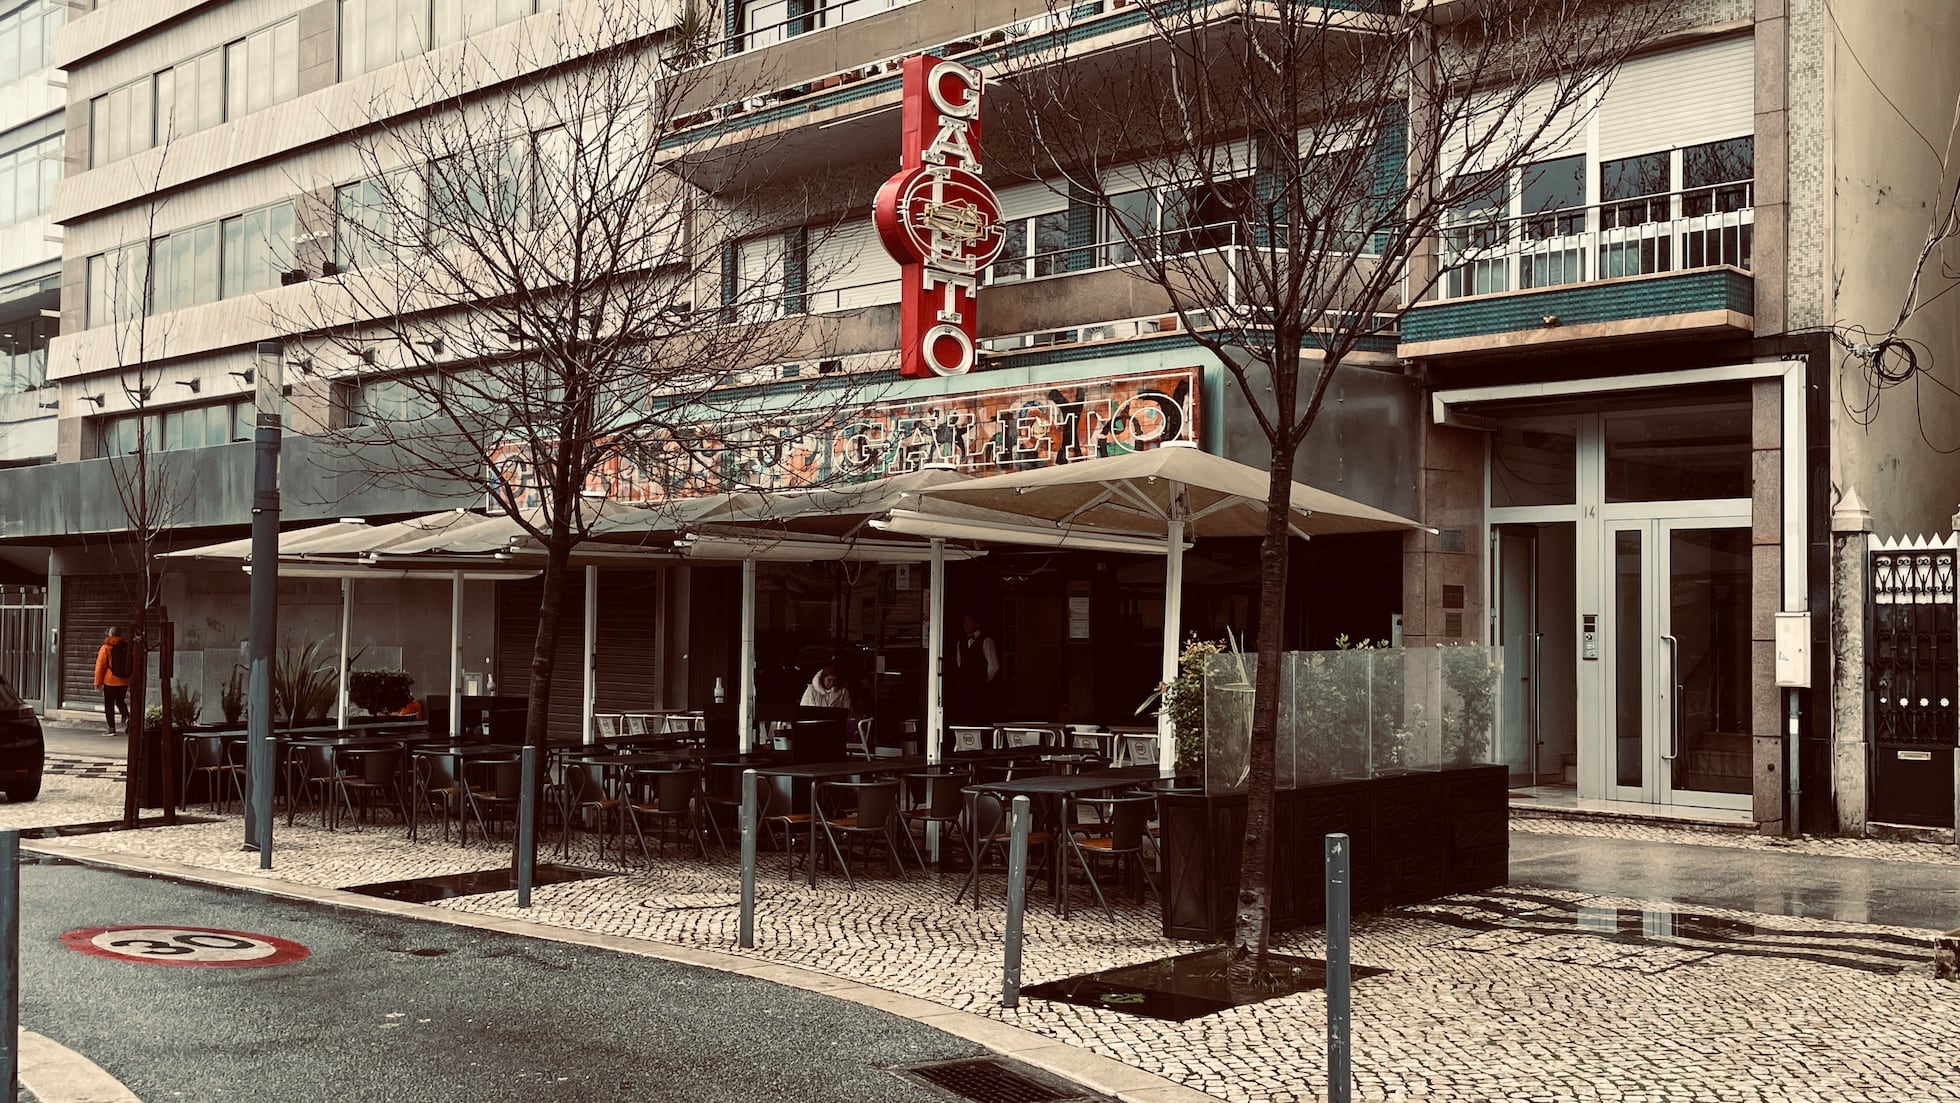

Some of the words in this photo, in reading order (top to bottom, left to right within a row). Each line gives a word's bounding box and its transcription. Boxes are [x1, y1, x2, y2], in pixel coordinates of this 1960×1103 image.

[921, 61, 982, 377] GALETO
[832, 393, 1184, 476] GALETO
[1584, 505, 1595, 519] 14
[110, 934, 256, 955] 30
